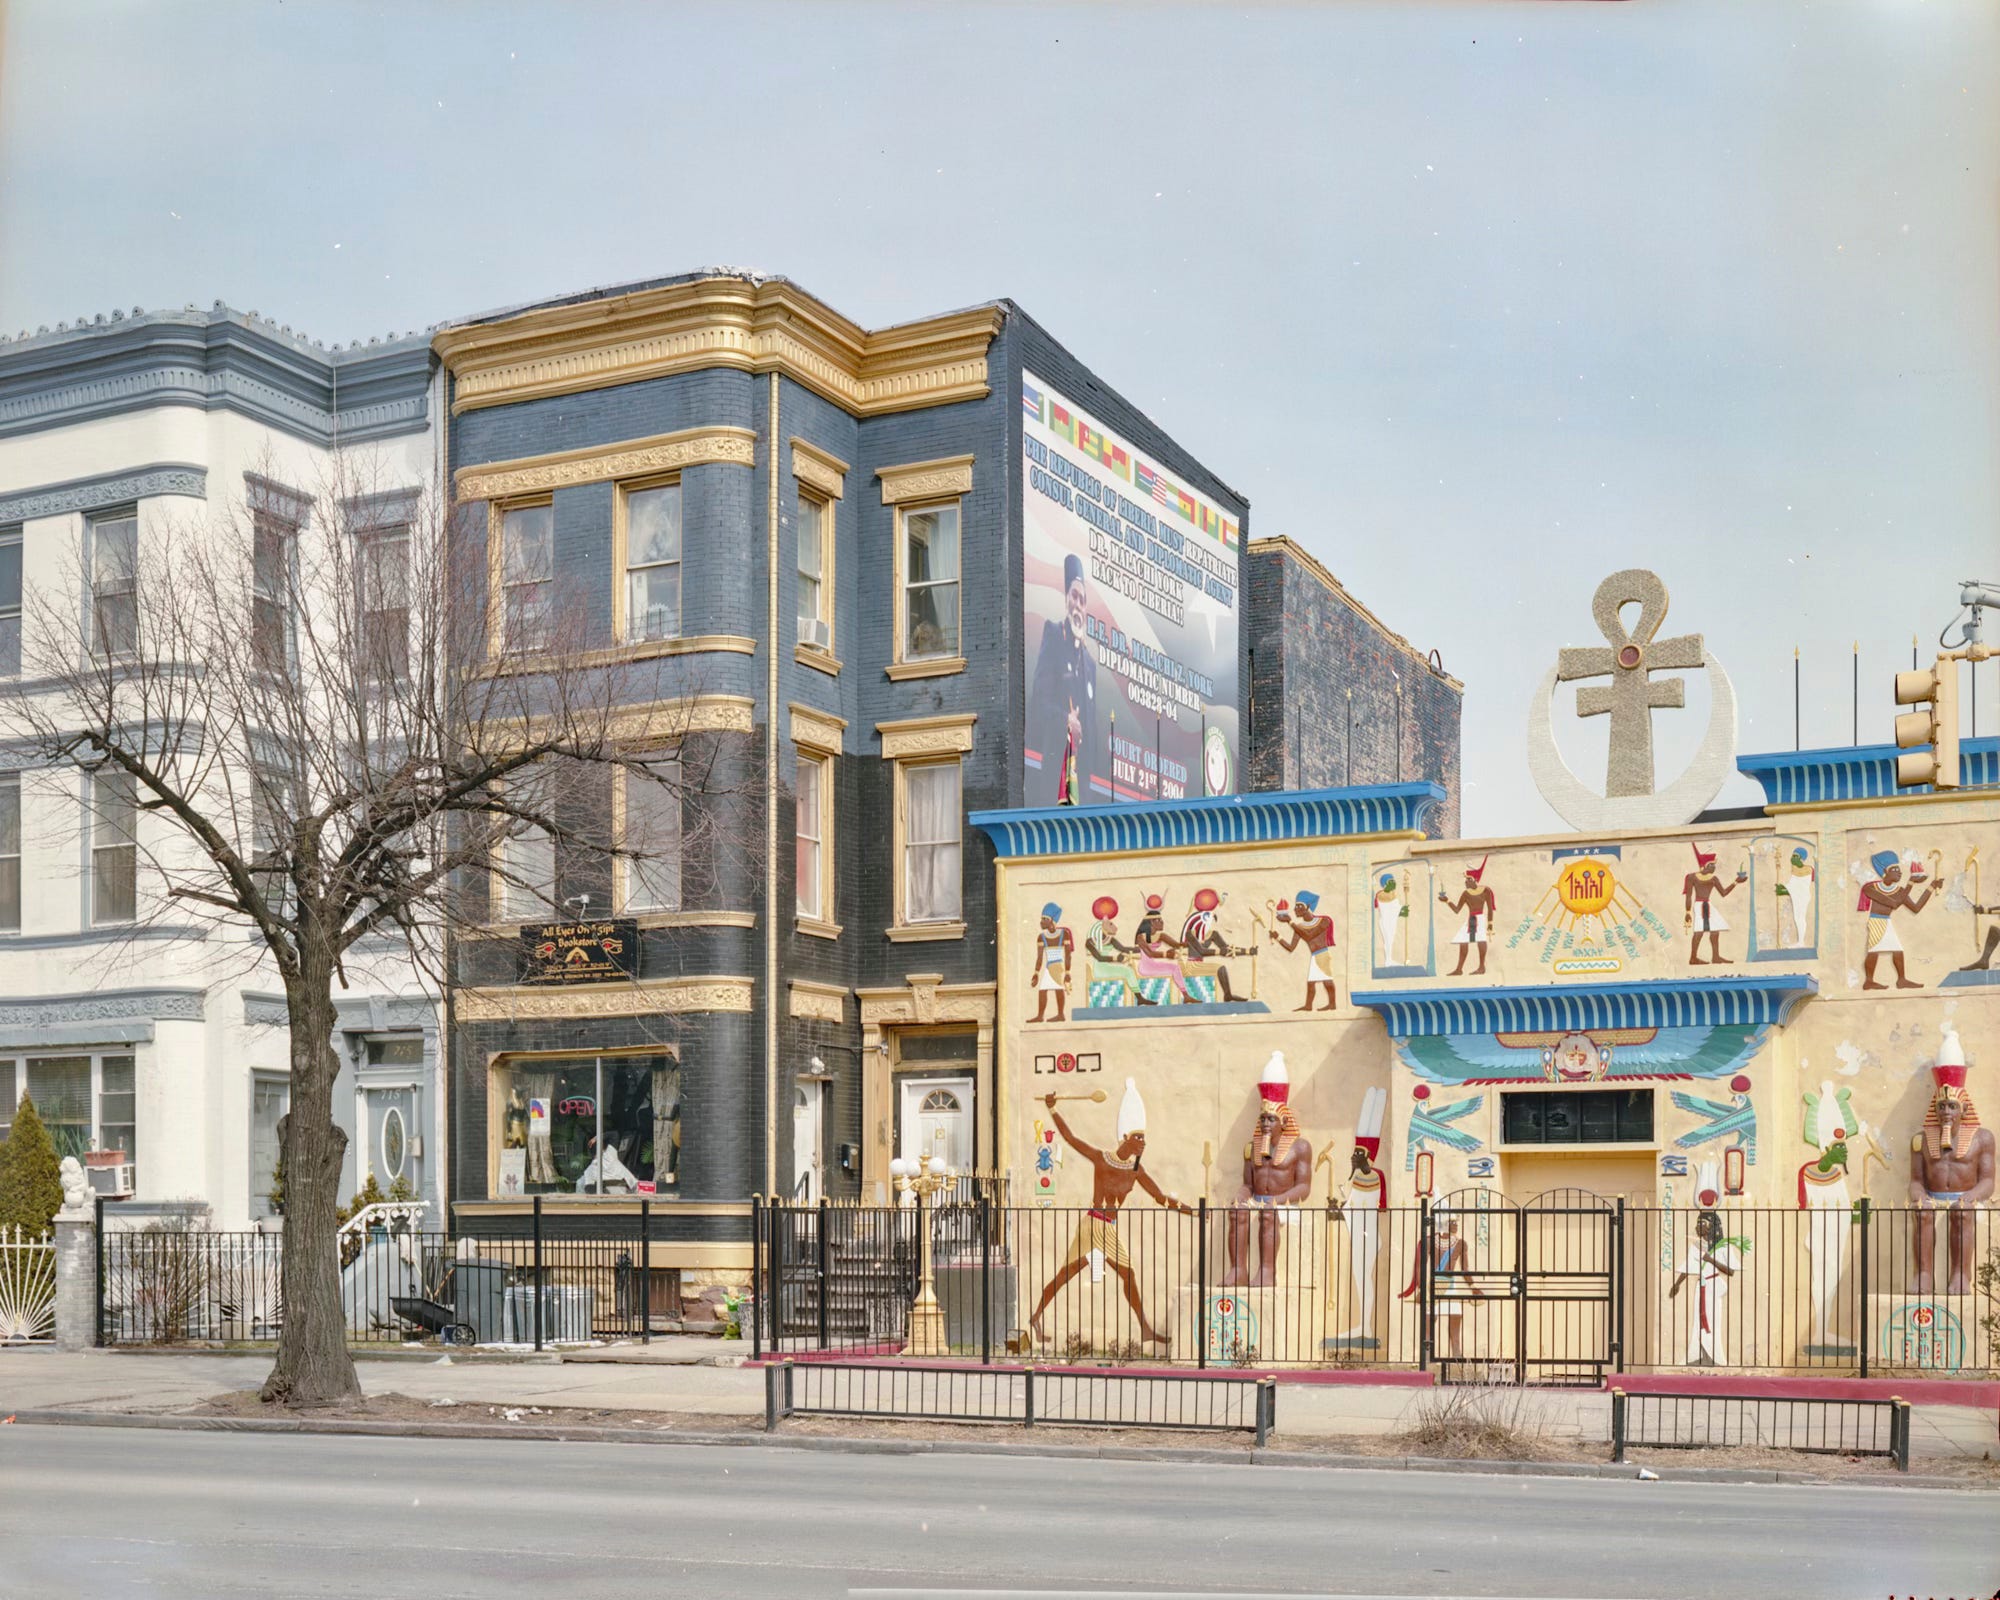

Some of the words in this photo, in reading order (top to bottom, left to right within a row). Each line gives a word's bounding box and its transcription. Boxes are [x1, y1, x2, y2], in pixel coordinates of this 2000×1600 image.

[1024, 432, 1048, 469] THE
[1049, 449, 1102, 503] REPUBLIC
[1102, 485, 1117, 512] OF
[1118, 494, 1158, 539] LIBERIA
[1159, 520, 1185, 555] MUST
[1185, 538, 1237, 589] REPATRIATE
[1030, 465, 1074, 512] CONSUL
[1075, 493, 1123, 543] GENERAL
[1124, 524, 1146, 555] AND
[1147, 538, 1204, 591] DIPLOMATIC
[1204, 574, 1233, 609] AGENT
[1089, 528, 1108, 559] DR.
[1110, 541, 1155, 587] MALACHI
[1156, 568, 1184, 603] YORK
[1092, 556, 1121, 593] BACK
[1123, 573, 1137, 601] TO
[1098, 645, 1160, 690] DIPLOMATIC
[1161, 677, 1200, 713] NUMBER
[1111, 627, 1129, 655] DR.
[1131, 638, 1175, 677] MALACHI
[1187, 669, 1213, 698] YORK
[1108, 735, 1142, 764] COURT
[1144, 750, 1187, 783] ORDERED
[1112, 758, 1136, 783] JULY
[1162, 779, 1184, 800] 2004
[577, 924, 590, 934] On
[381, 1088, 401, 1100] 715
[559, 1098, 594, 1116] OPEN
